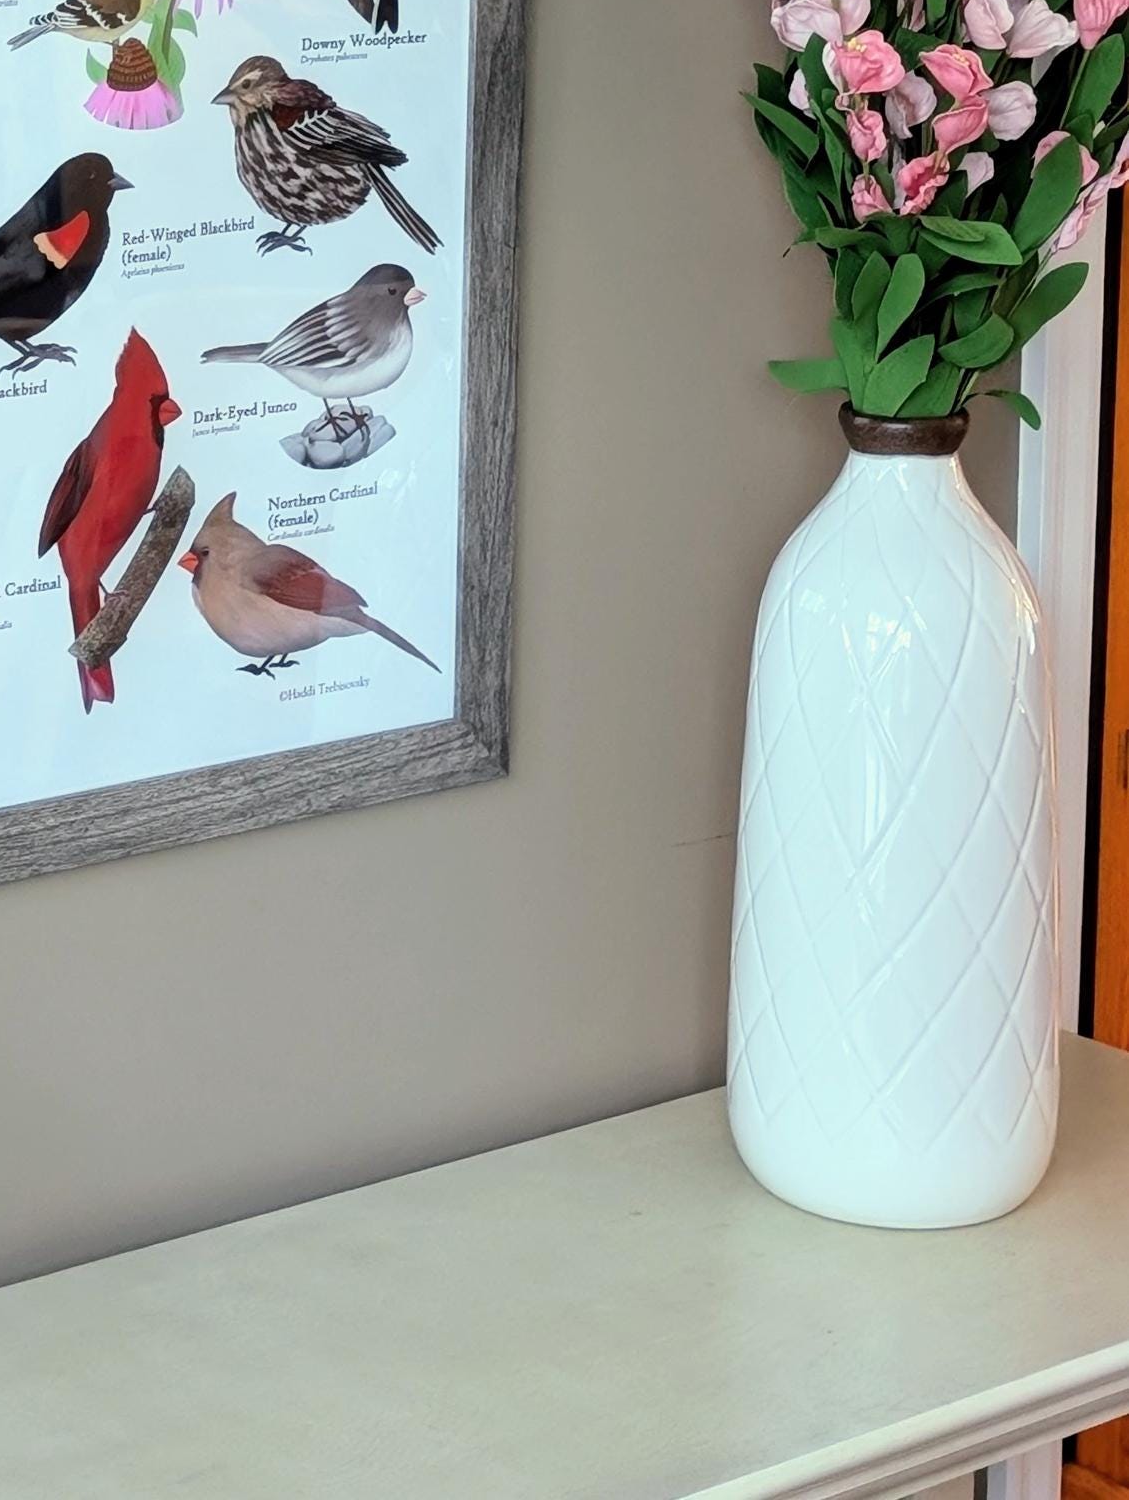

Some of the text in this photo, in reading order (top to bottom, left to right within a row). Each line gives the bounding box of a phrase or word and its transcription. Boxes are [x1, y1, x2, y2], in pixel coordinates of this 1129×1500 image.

[301, 32, 427, 54] Downy Woodpecker
[122, 215, 255, 246] Red-Winged Blackbird
[121, 244, 172, 266] (female)
[193, 401, 297, 424] Dark-Eyed Junco
[267, 482, 377, 511] Northern Cardinal
[267, 508, 319, 529] (female)
[4, 576, 61, 596] Cardinal
